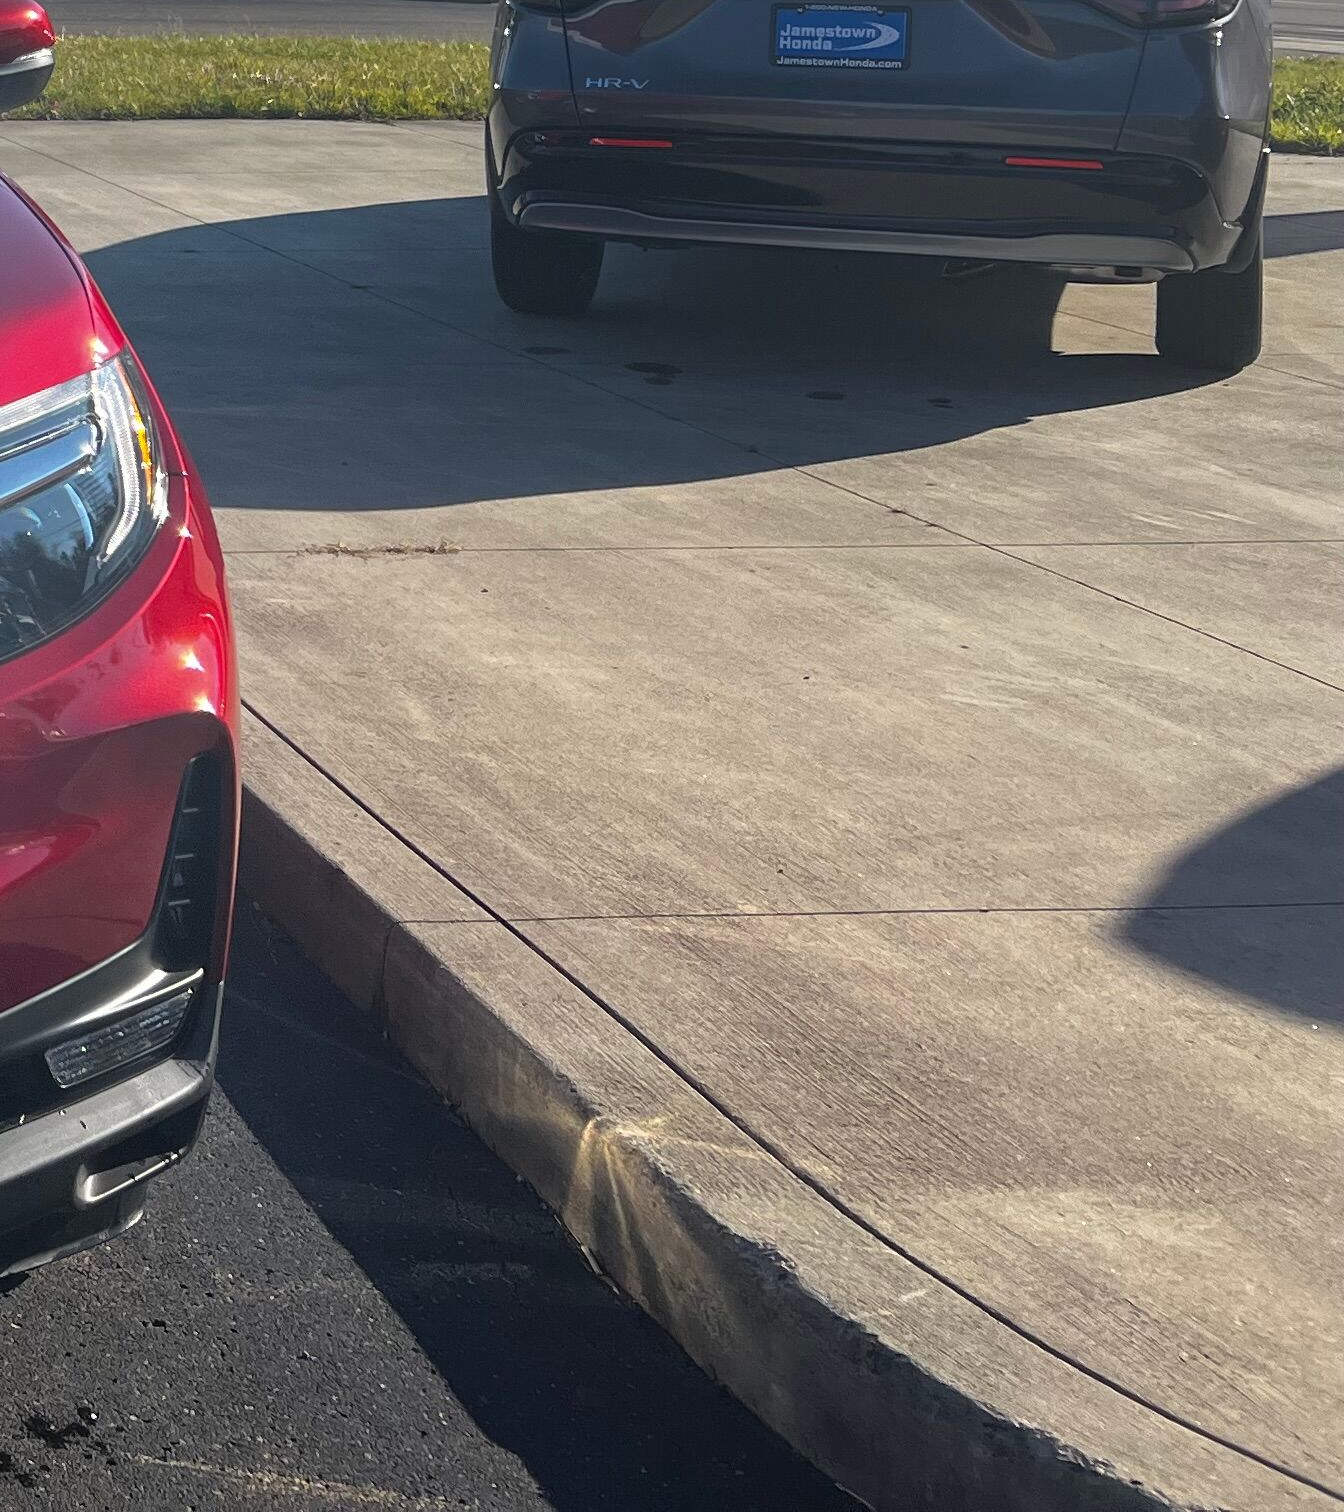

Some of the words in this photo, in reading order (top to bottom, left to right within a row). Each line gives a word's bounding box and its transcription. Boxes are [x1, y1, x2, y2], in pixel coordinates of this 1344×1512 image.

[780, 23, 876, 38] Jamestown
[779, 36, 832, 50] Honda
[776, 55, 902, 68] JamestownHonda.com
[585, 77, 649, 89] HR-V
